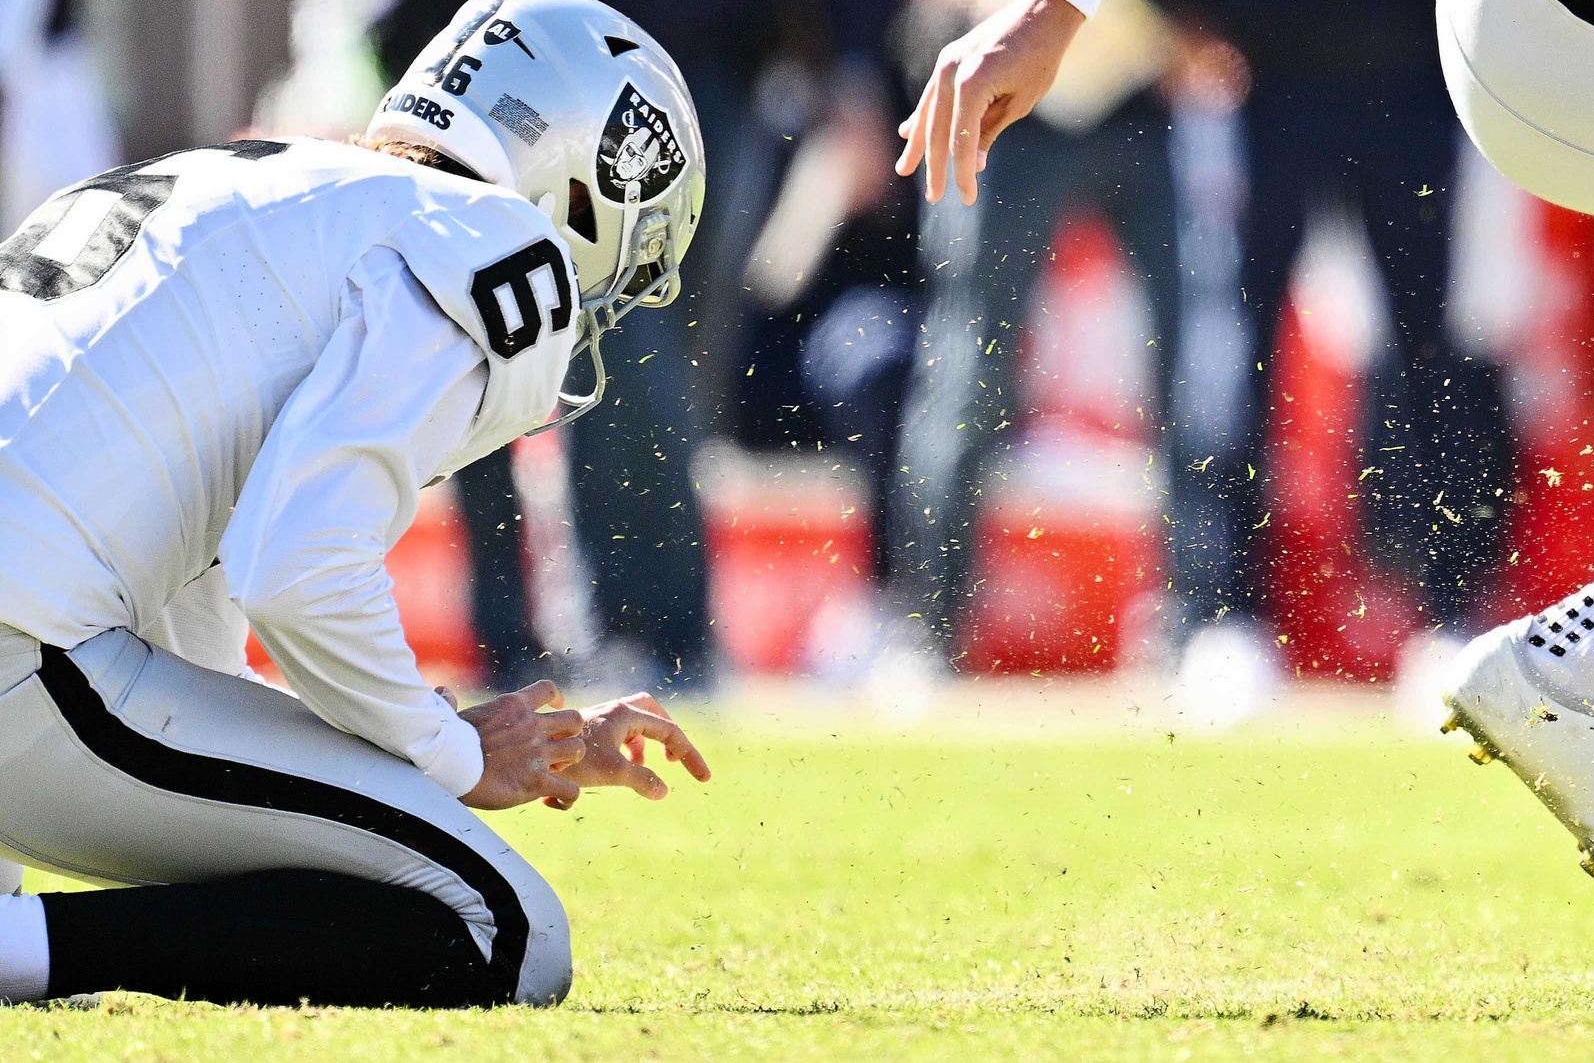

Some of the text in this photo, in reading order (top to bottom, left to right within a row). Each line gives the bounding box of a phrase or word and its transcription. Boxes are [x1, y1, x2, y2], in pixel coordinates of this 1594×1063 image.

[487, 24, 511, 39] AL
[442, 55, 482, 96] 6
[629, 92, 685, 164] RAIDERS
[467, 236, 573, 363] 6
